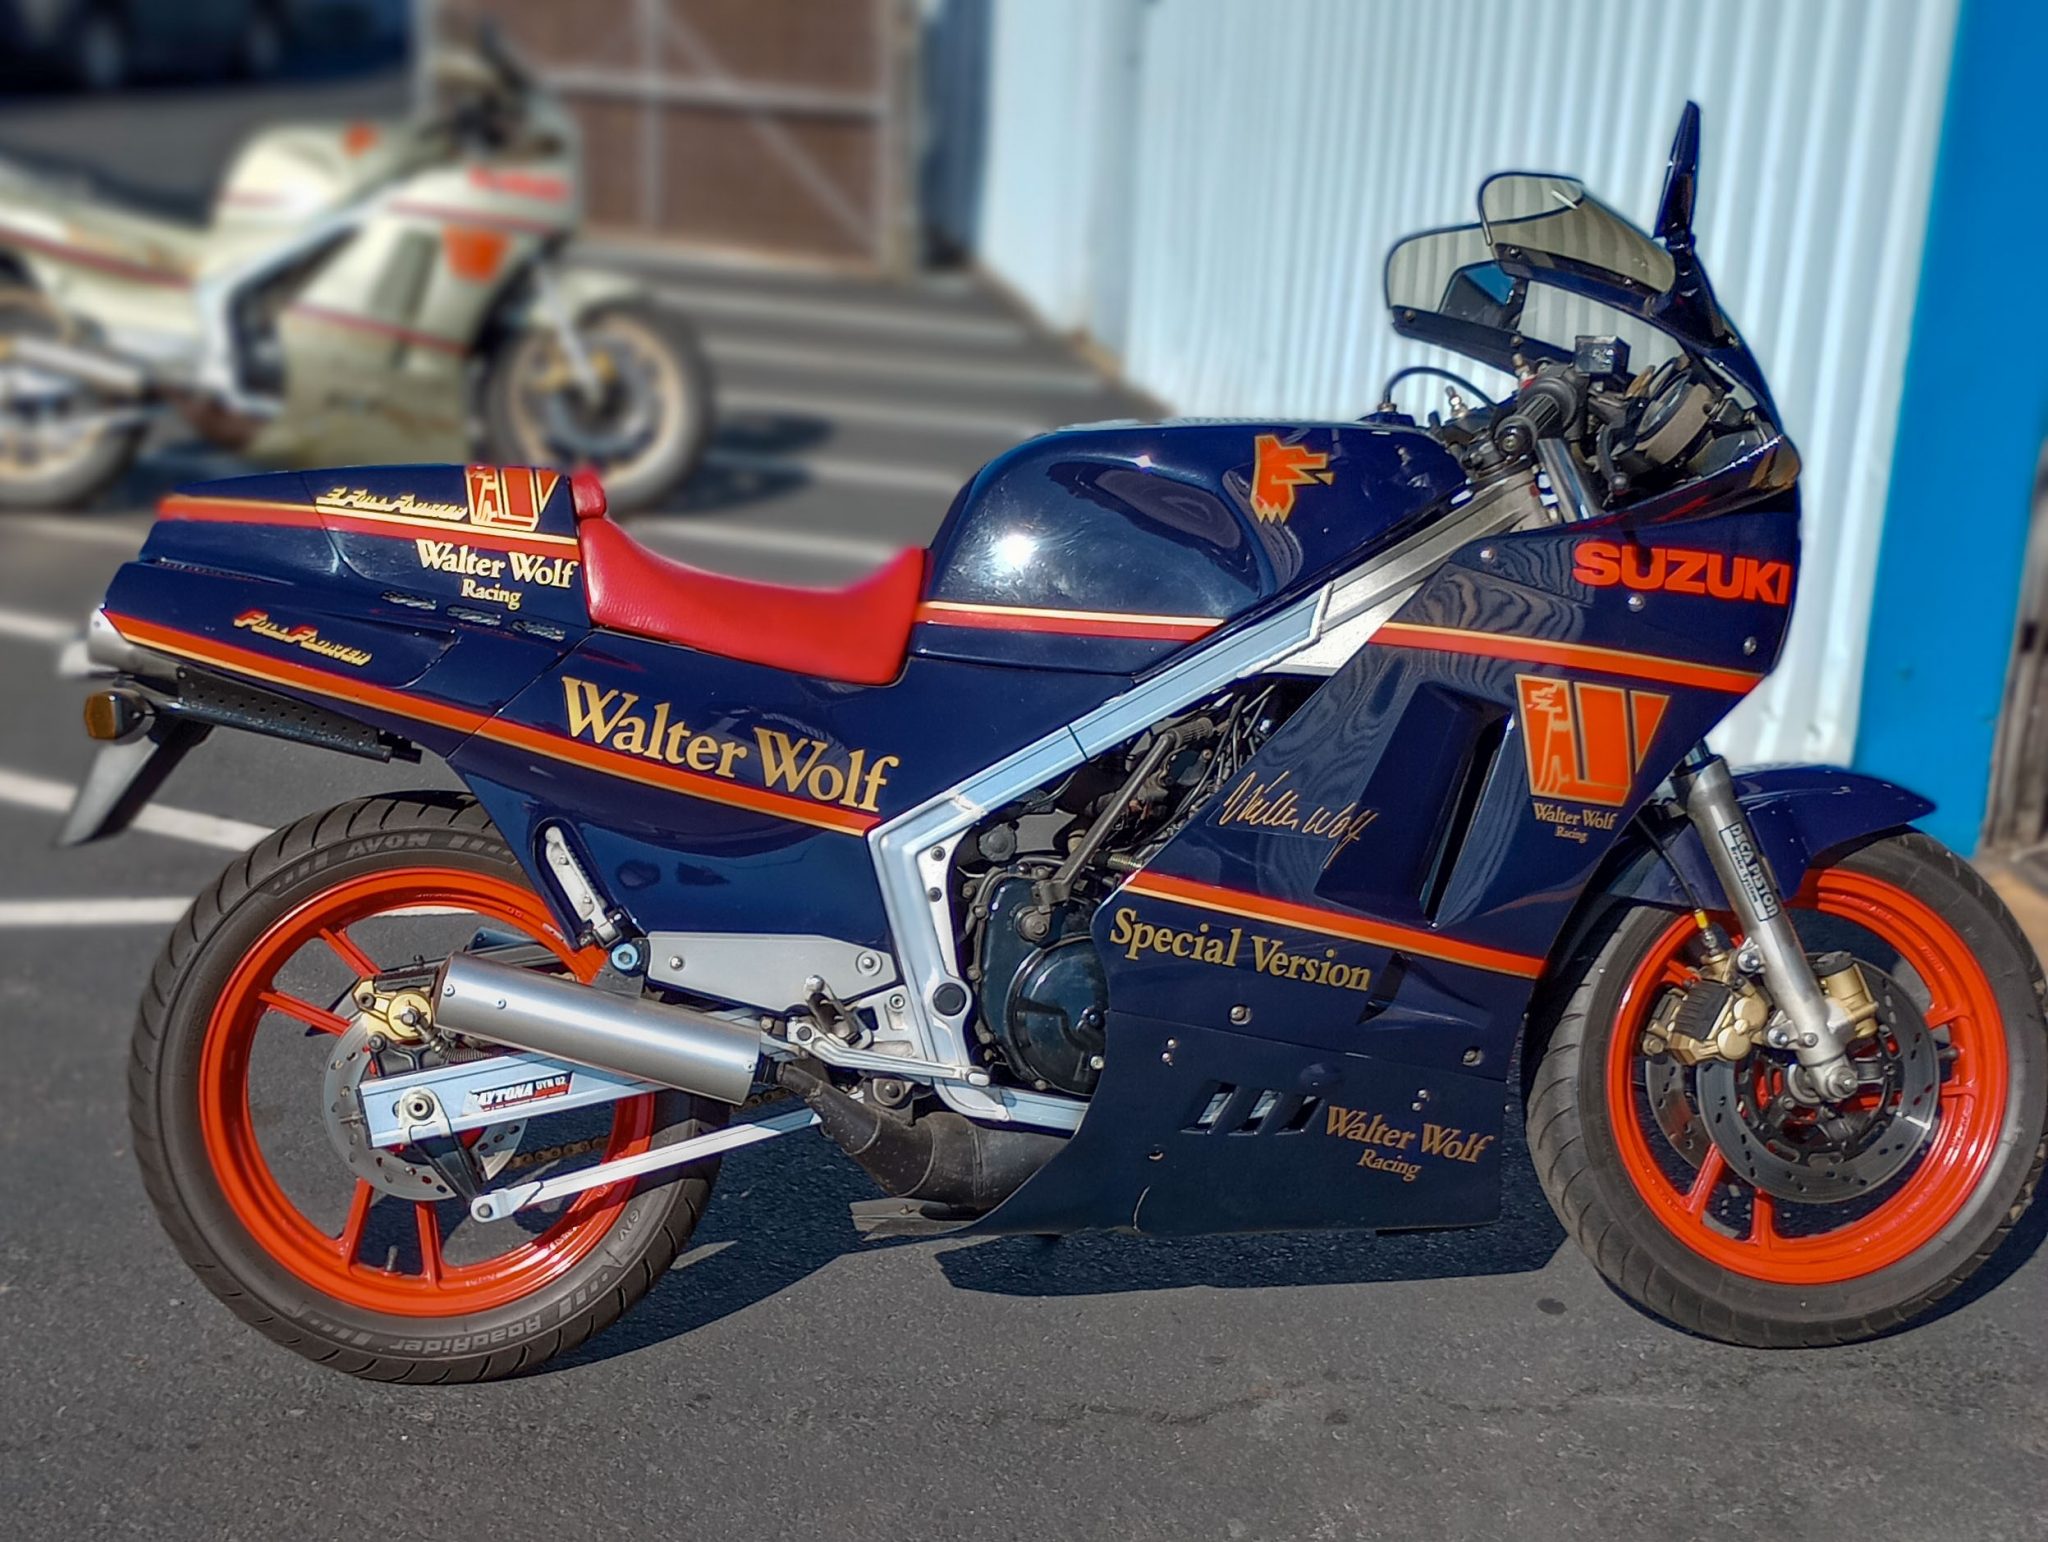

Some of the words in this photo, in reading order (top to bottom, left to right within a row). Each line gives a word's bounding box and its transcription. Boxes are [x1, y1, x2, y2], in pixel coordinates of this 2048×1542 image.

[416, 539, 505, 578] Walter
[508, 551, 578, 589] Wolf
[1573, 541, 1790, 604] SUZUKI
[461, 579, 522, 610] Racing
[561, 676, 747, 778] Walter
[753, 727, 899, 812] Wolf
[1533, 802, 1580, 826] Walter
[1582, 809, 1618, 830] Wolf
[1555, 825, 1589, 843] Racing
[345, 833, 432, 858] AVON
[1110, 907, 1242, 967] Special
[1250, 935, 1372, 992] Version
[1326, 1105, 1416, 1149] Walter
[1421, 1123, 1495, 1163] Wolf
[1357, 1149, 1422, 1182] Racing
[390, 1316, 542, 1355] RoadRider
